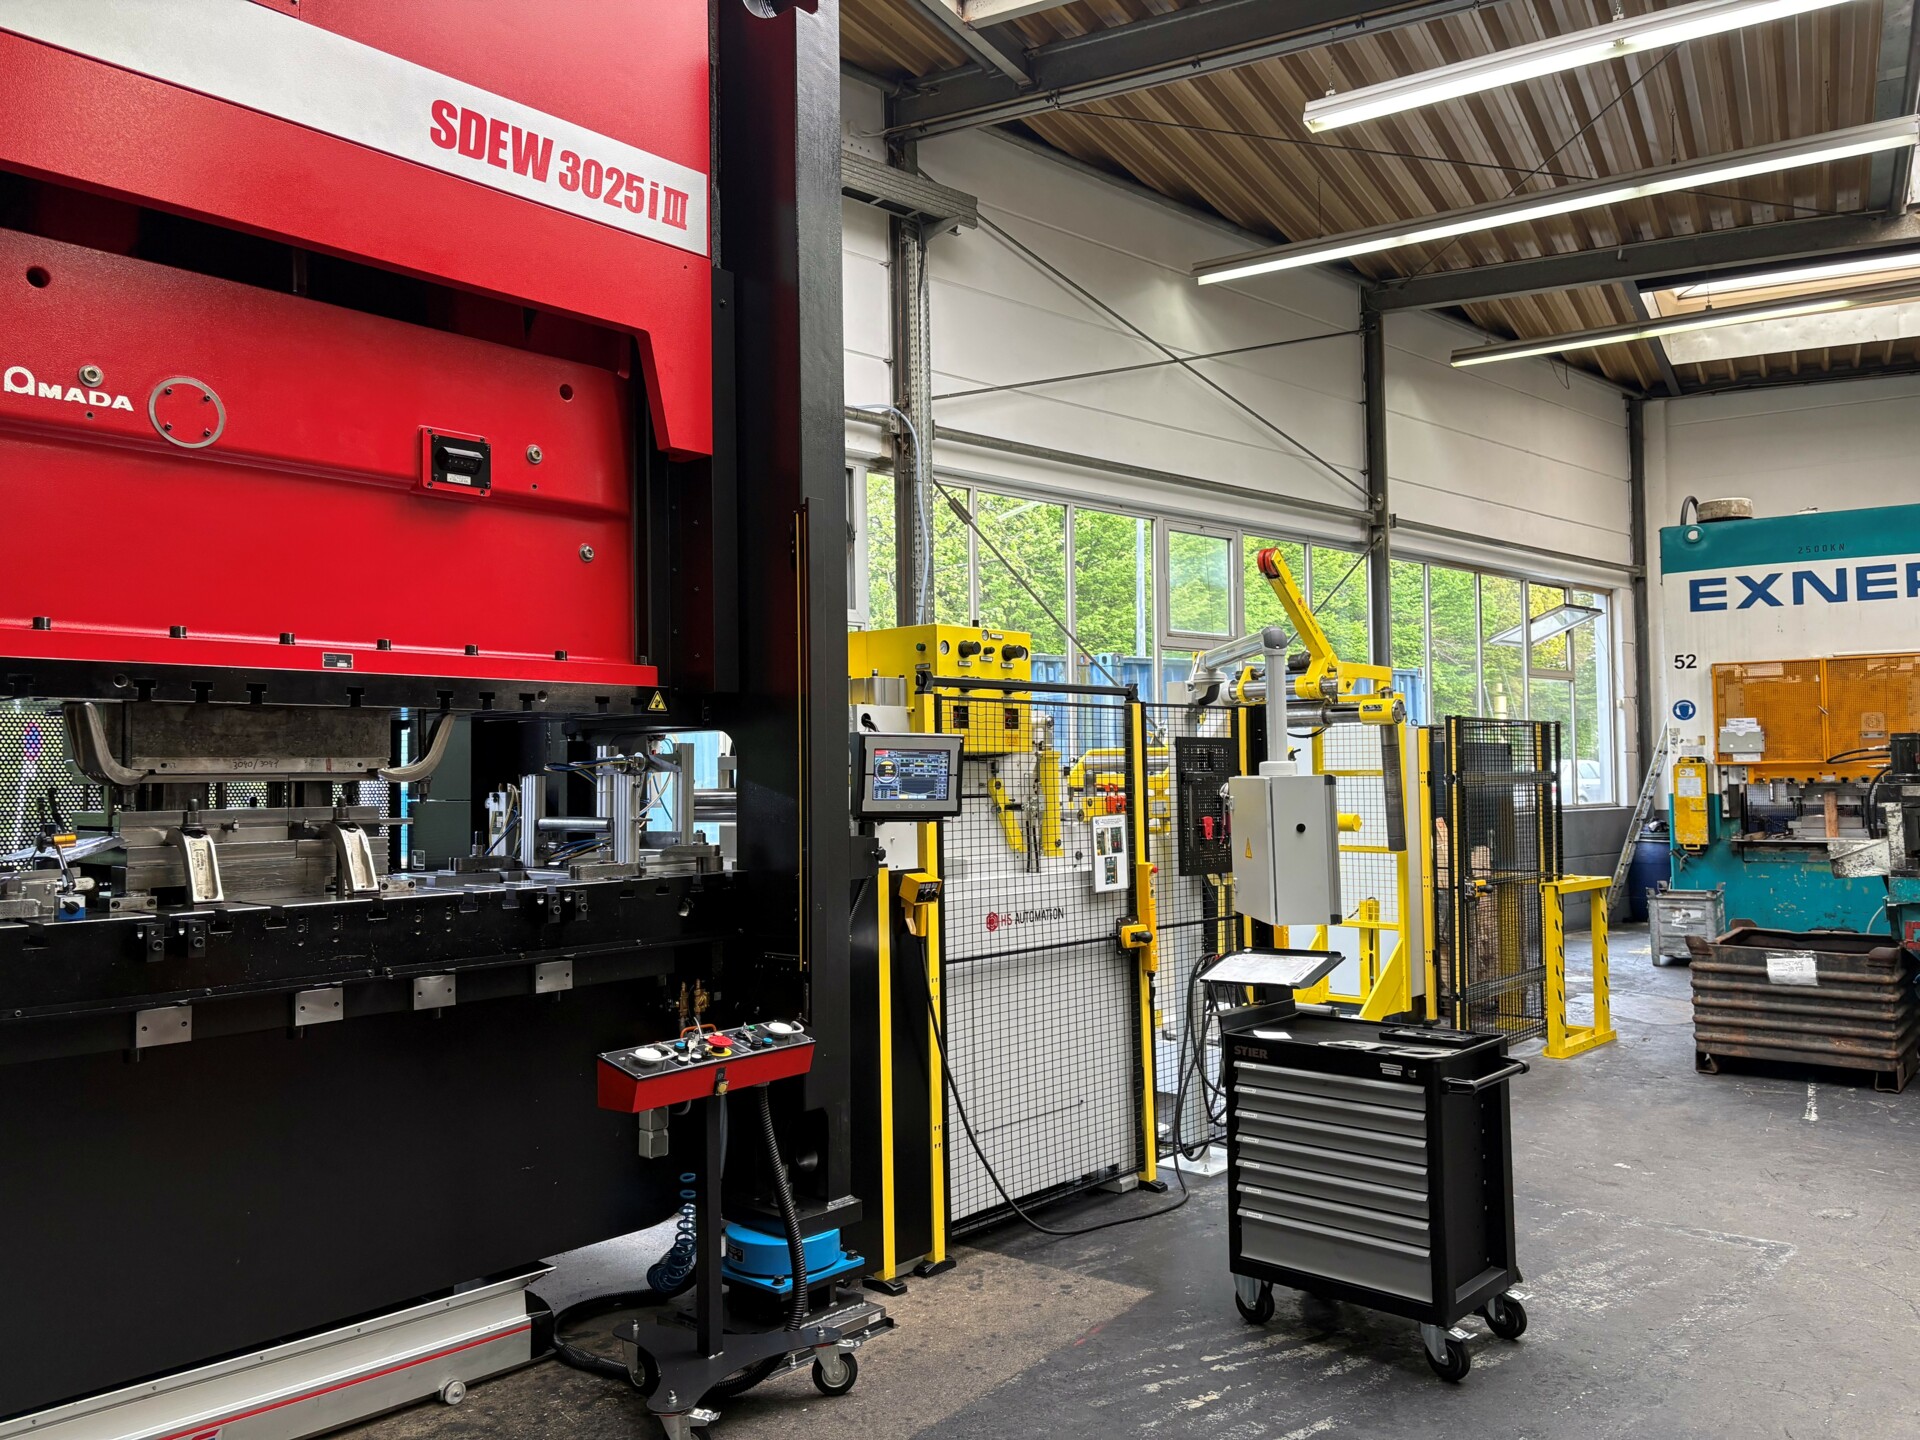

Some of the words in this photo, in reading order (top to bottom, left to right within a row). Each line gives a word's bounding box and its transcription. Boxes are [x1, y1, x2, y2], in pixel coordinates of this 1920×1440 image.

[430, 99, 554, 183] SDEW
[3, 366, 135, 412] AMADA
[1797, 543, 1846, 555] 2500KN
[1674, 654, 1697, 669] 52
[1015, 907, 1064, 925] AUTOMATION
[1233, 1045, 1269, 1060] STIER
